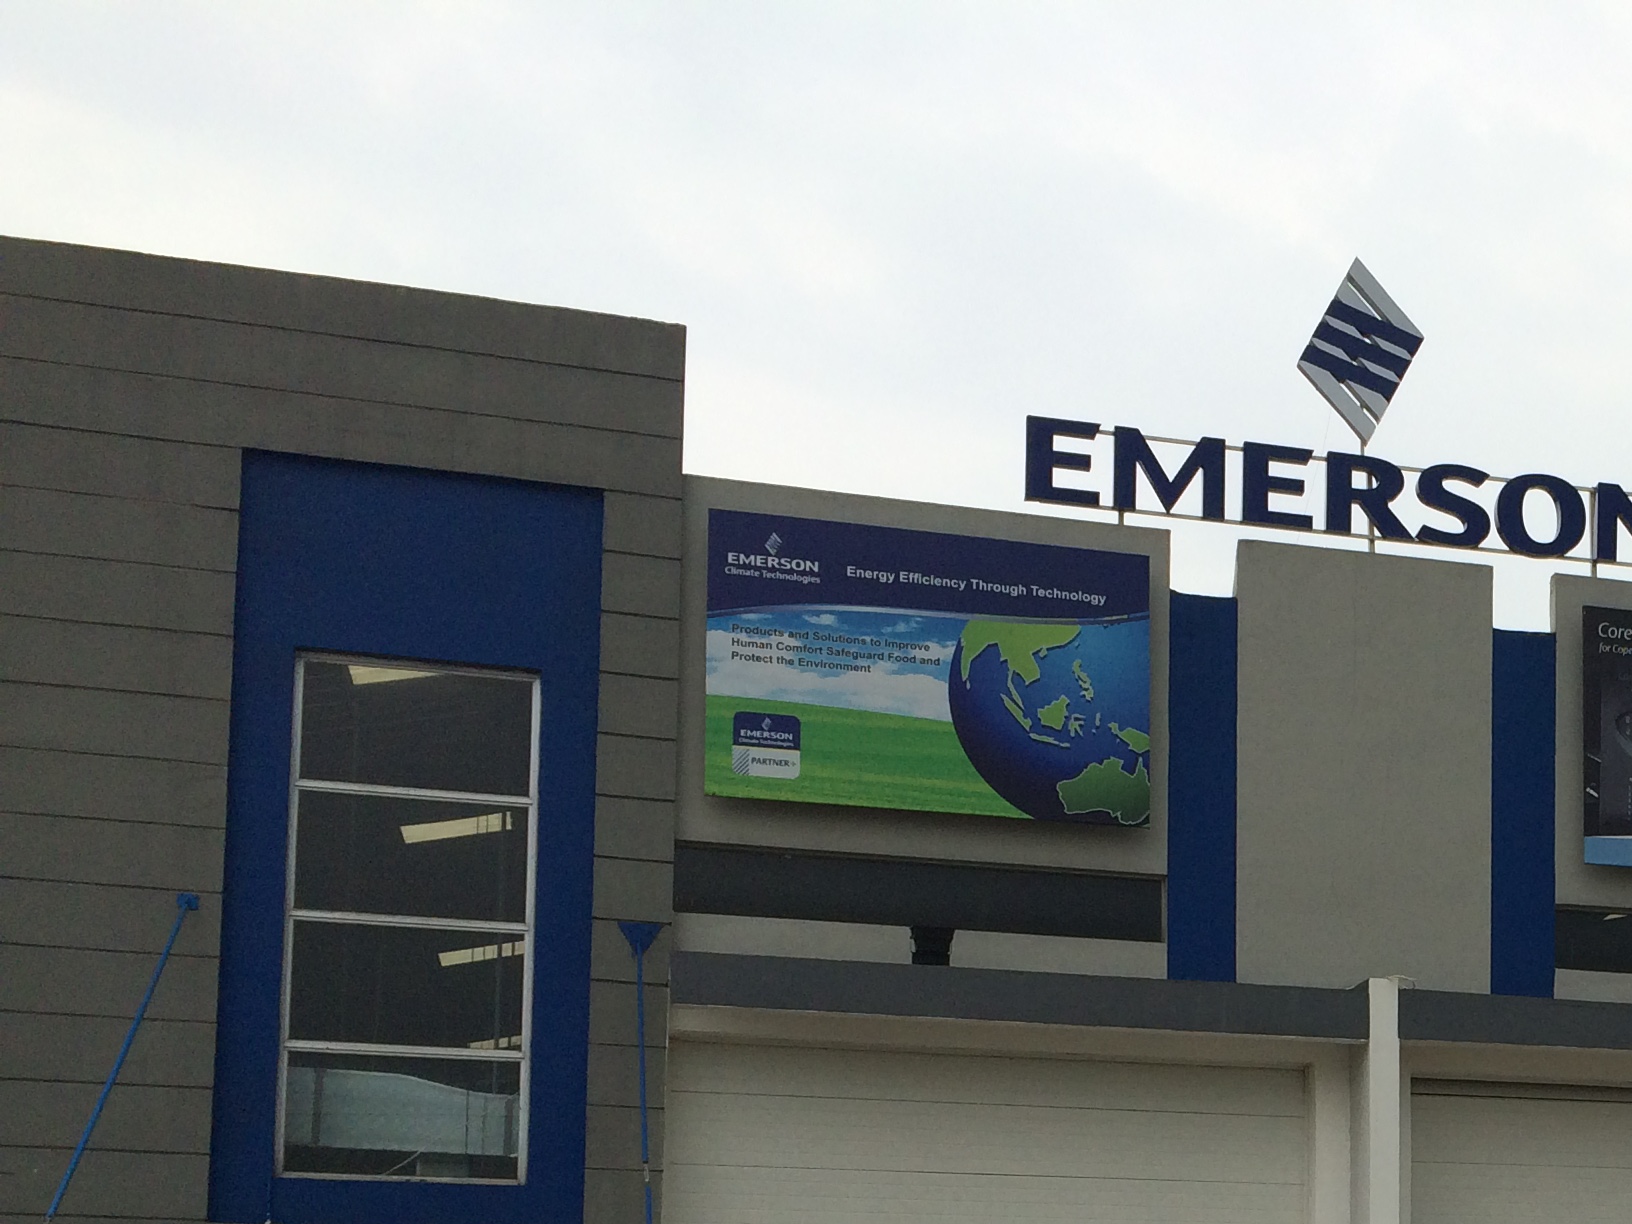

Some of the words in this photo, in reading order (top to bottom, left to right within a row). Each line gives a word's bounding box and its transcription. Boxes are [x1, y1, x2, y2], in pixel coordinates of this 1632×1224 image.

[727, 552, 819, 573] EMERSON
[724, 566, 760, 578] Climate
[762, 570, 821, 585] Technologies
[846, 565, 896, 583] Energy
[899, 571, 967, 591] Efficiency
[970, 578, 1027, 597] Through
[1030, 585, 1107, 606] Technology
[731, 624, 784, 638] Products
[788, 627, 809, 640] and
[812, 631, 867, 646] Solutions
[870, 637, 882, 647] to
[884, 639, 931, 653] Improve
[1598, 642, 1612, 654] for
[731, 637, 773, 650] Human
[776, 641, 823, 655] Comfort
[826, 646, 885, 663] Safeguard
[887, 652, 917, 664] Food
[919, 656, 941, 667] and
[731, 651, 774, 665] Protect
[776, 655, 795, 666] the
[797, 658, 872, 673] Environment
[740, 729, 793, 741] EMERSON
